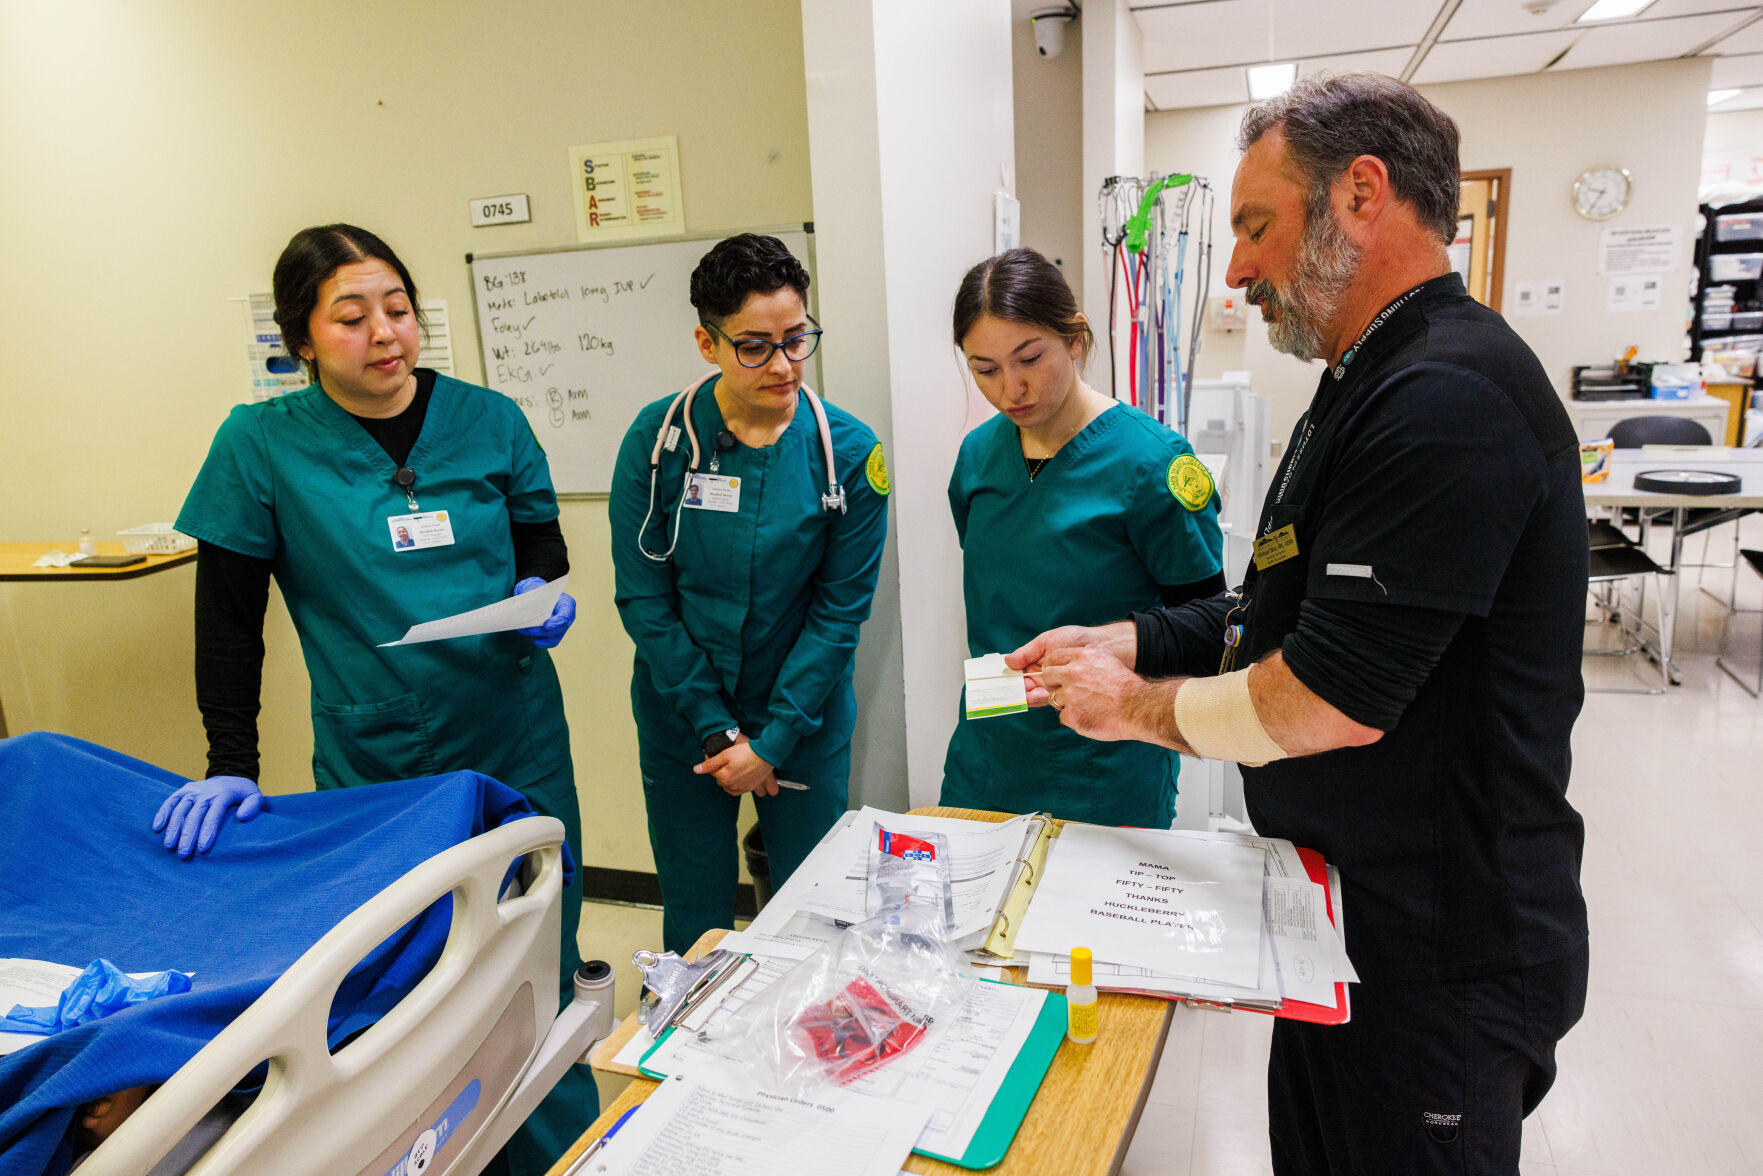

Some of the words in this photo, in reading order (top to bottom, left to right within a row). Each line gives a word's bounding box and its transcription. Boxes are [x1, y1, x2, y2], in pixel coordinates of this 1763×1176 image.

[584, 159, 595, 175] S
[585, 176, 597, 192] B
[483, 203, 513, 218] 0745
[588, 195, 599, 211] A
[589, 212, 601, 227] R
[1353, 317, 1384, 352] SUPPLY
[1138, 862, 1170, 871] MAMA
[1155, 873, 1176, 881] TOP
[1116, 879, 1144, 889] FIFTY
[1155, 885, 1184, 894] FIFTY
[1125, 892, 1169, 904] THANKS
[1090, 908, 1148, 924] BASEBALL
[1104, 901, 1185, 917] HUCKLEBERRY
[1423, 1111, 1462, 1121] CHEROKEE
